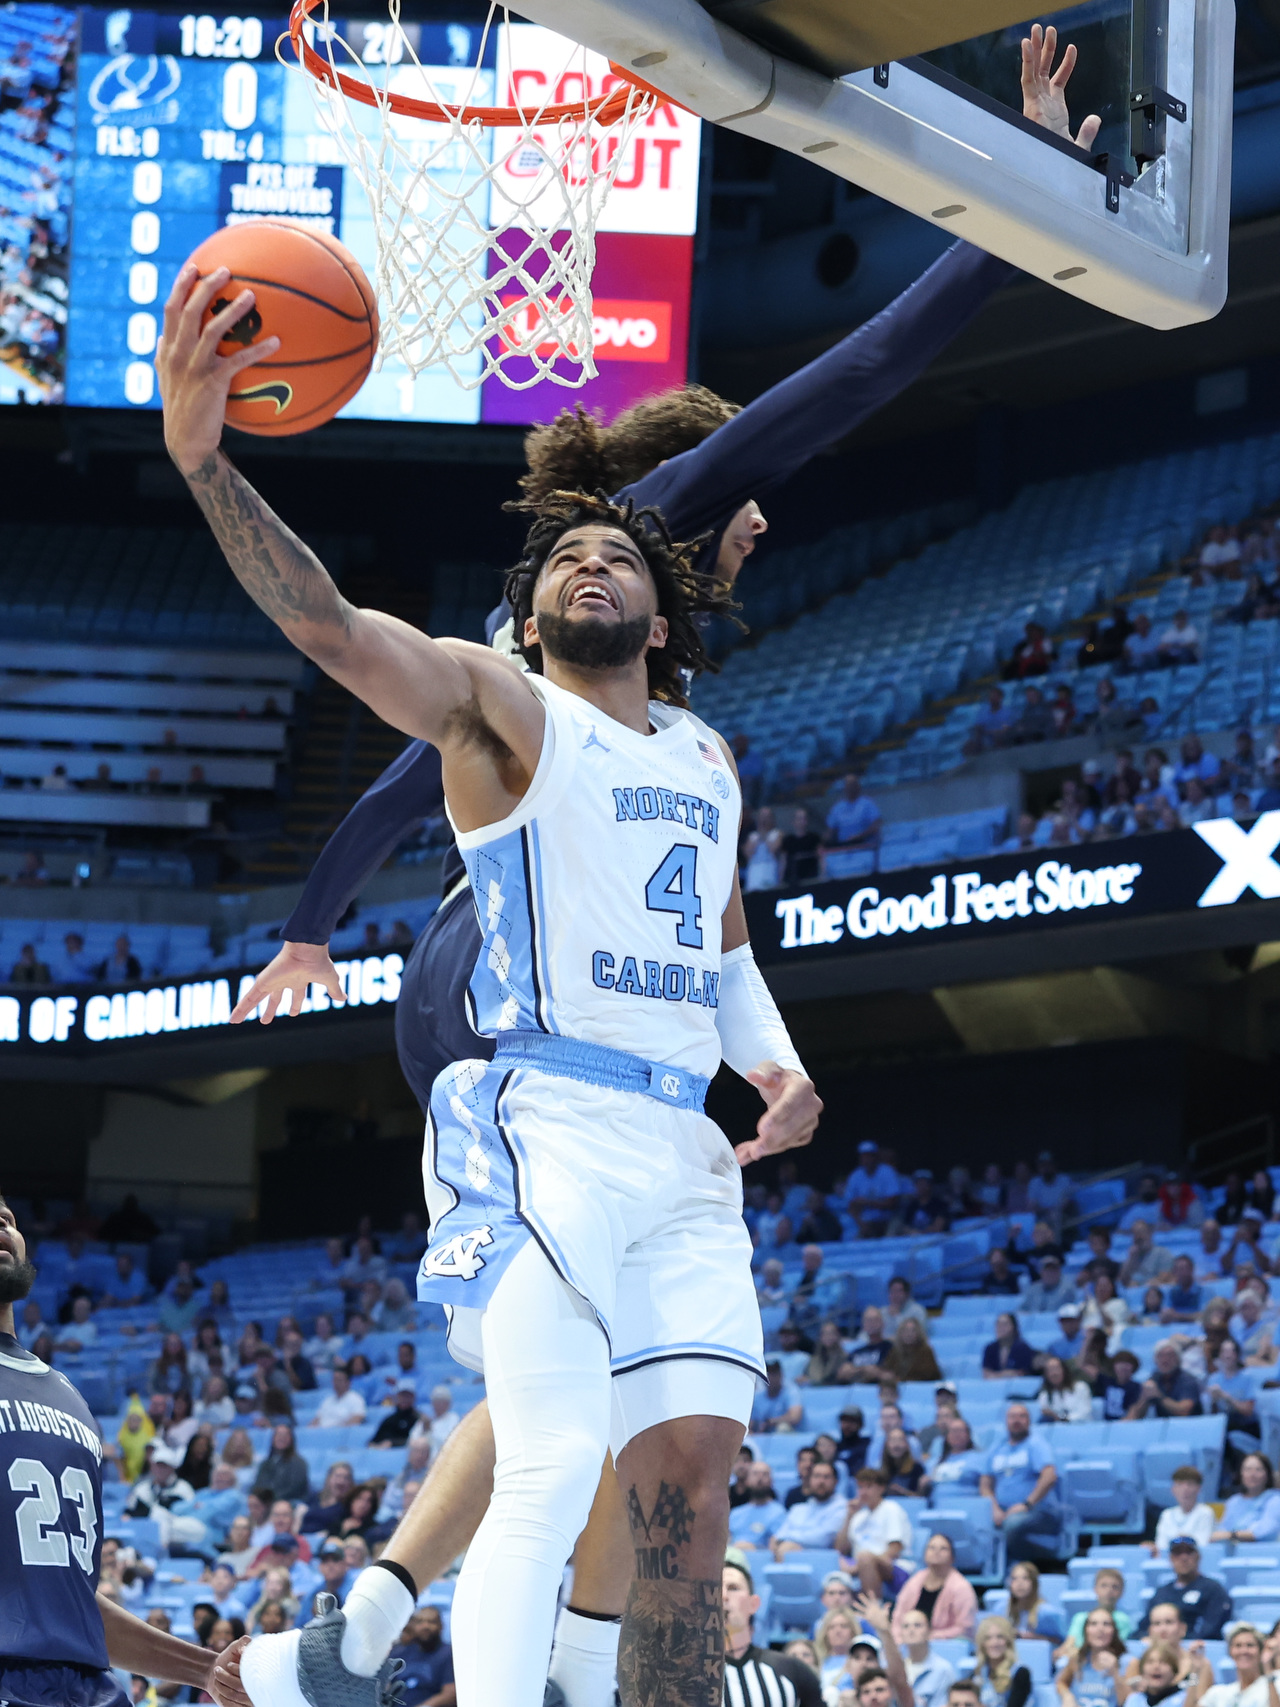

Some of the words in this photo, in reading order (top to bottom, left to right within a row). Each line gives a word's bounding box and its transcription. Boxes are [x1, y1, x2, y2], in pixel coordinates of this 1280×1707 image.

[179, 14, 263, 59] 18:20
[223, 62, 258, 130] 0
[133, 161, 162, 204] 0
[131, 211, 160, 254] 0
[129, 261, 158, 304] 0
[127, 312, 156, 355] 0
[125, 362, 154, 404] 0
[611, 787, 720, 845] NORTH
[645, 843, 704, 950] 4
[776, 894, 845, 948] The
[846, 874, 950, 940] Good
[951, 872, 1036, 926] Feet
[1033, 861, 1135, 918] Store
[29, 996, 77, 1043] OF
[84, 978, 231, 1042] CAROLINA
[7, 1457, 98, 1576] 23
[635, 1544, 679, 1580] TMC
